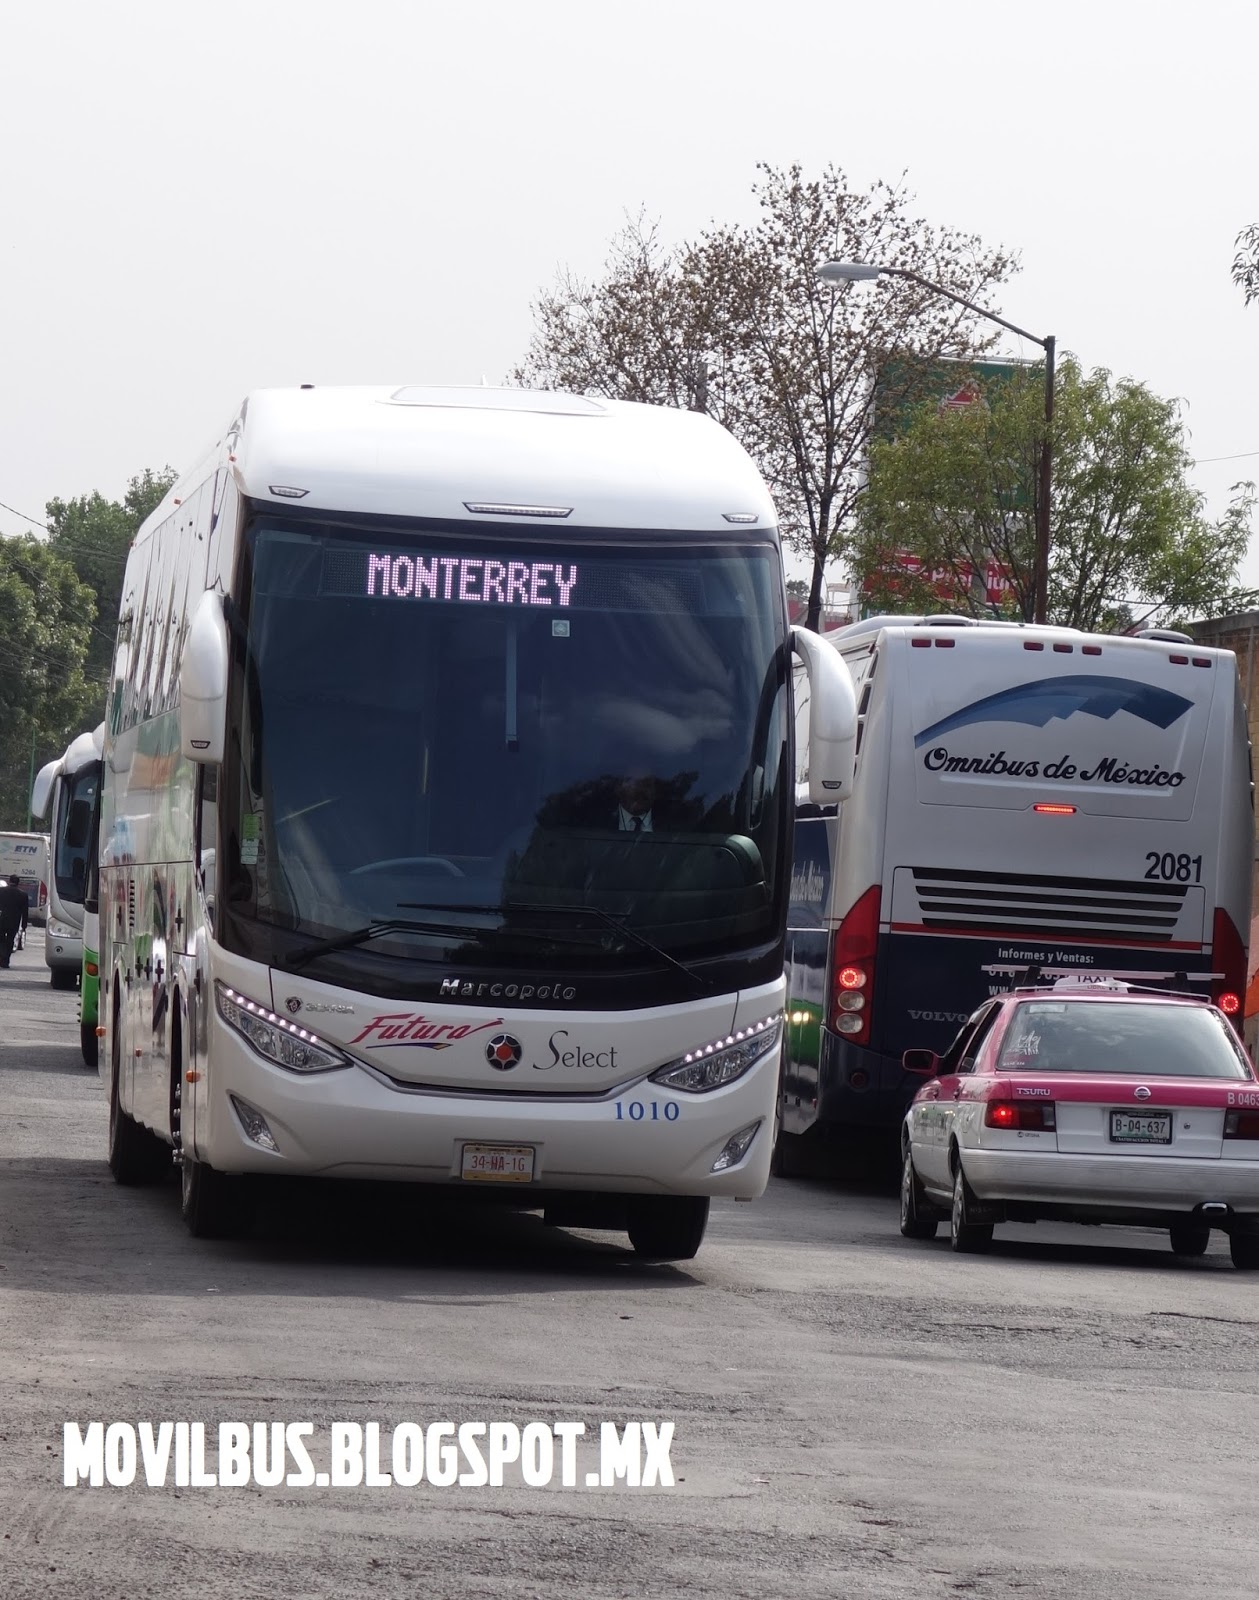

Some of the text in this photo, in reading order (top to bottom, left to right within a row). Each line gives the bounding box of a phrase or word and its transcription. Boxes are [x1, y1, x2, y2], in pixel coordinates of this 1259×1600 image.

[367, 553, 577, 606] MONTERREY
[924, 747, 1186, 787] Omnibus de México
[14, 845, 38, 854] ETN
[1144, 851, 1202, 883] 2081
[998, 948, 1094, 964] Informes y Ventas:
[1077, 975, 1107, 983] TAXI
[440, 978, 576, 1000] Marcopolo
[907, 1009, 970, 1023] VOLVO
[347, 1013, 504, 1045] Futura
[532, 1030, 618, 1070] Select
[1016, 1087, 1051, 1096] TSURU
[1227, 1092, 1236, 1105] B
[614, 1101, 680, 1121] 1010
[1115, 1118, 1166, 1134] B-04-637
[471, 1155, 525, 1172] 34-HA-1G
